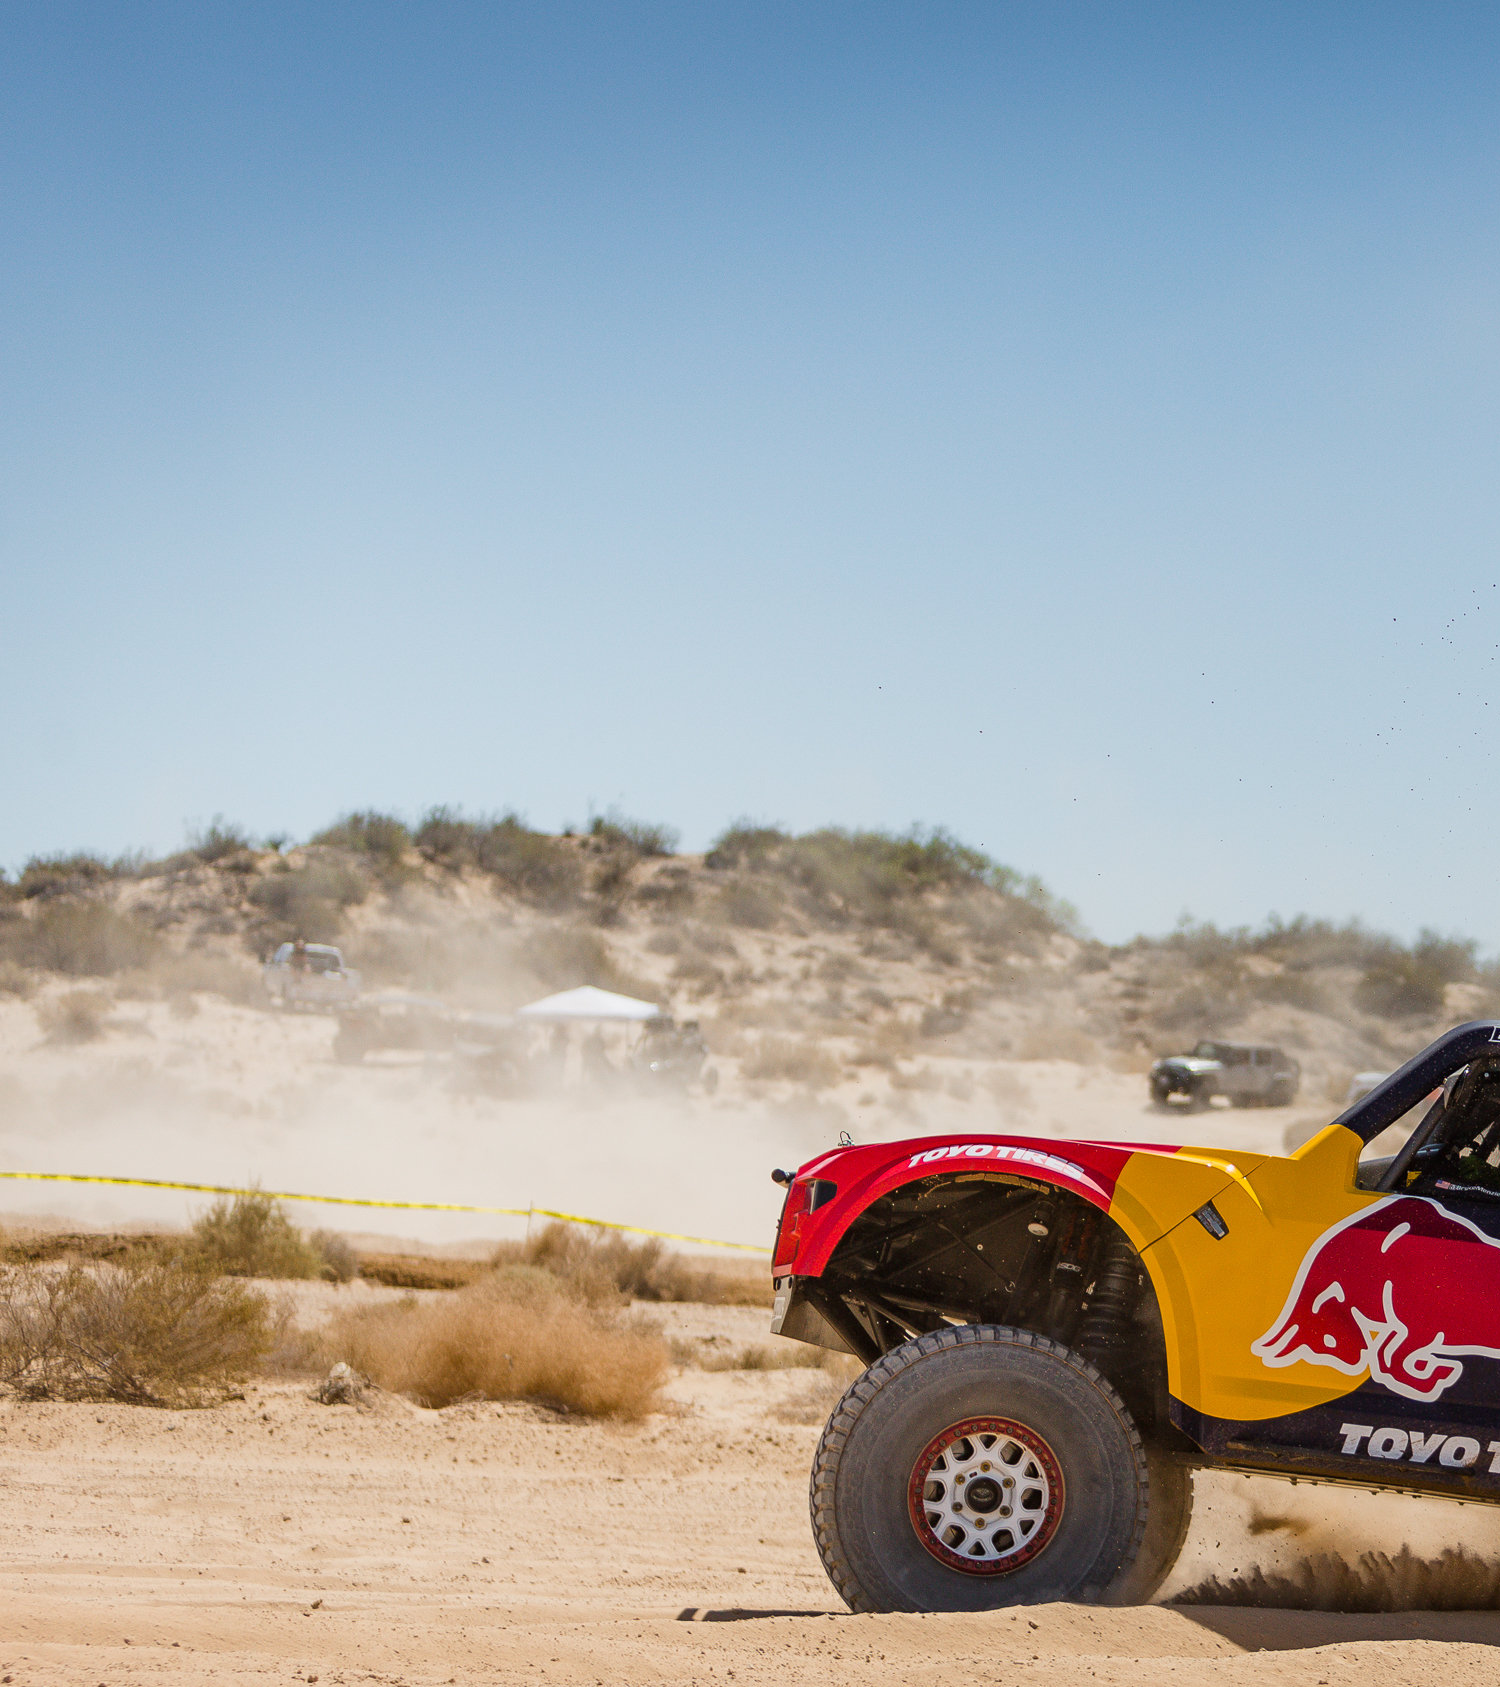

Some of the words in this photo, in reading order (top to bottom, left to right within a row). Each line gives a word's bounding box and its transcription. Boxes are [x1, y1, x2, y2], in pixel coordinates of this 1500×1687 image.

[907, 1144, 994, 1168] TOYO
[996, 1146, 1085, 1180] TIRES
[1339, 1422, 1481, 1468] TOYO
